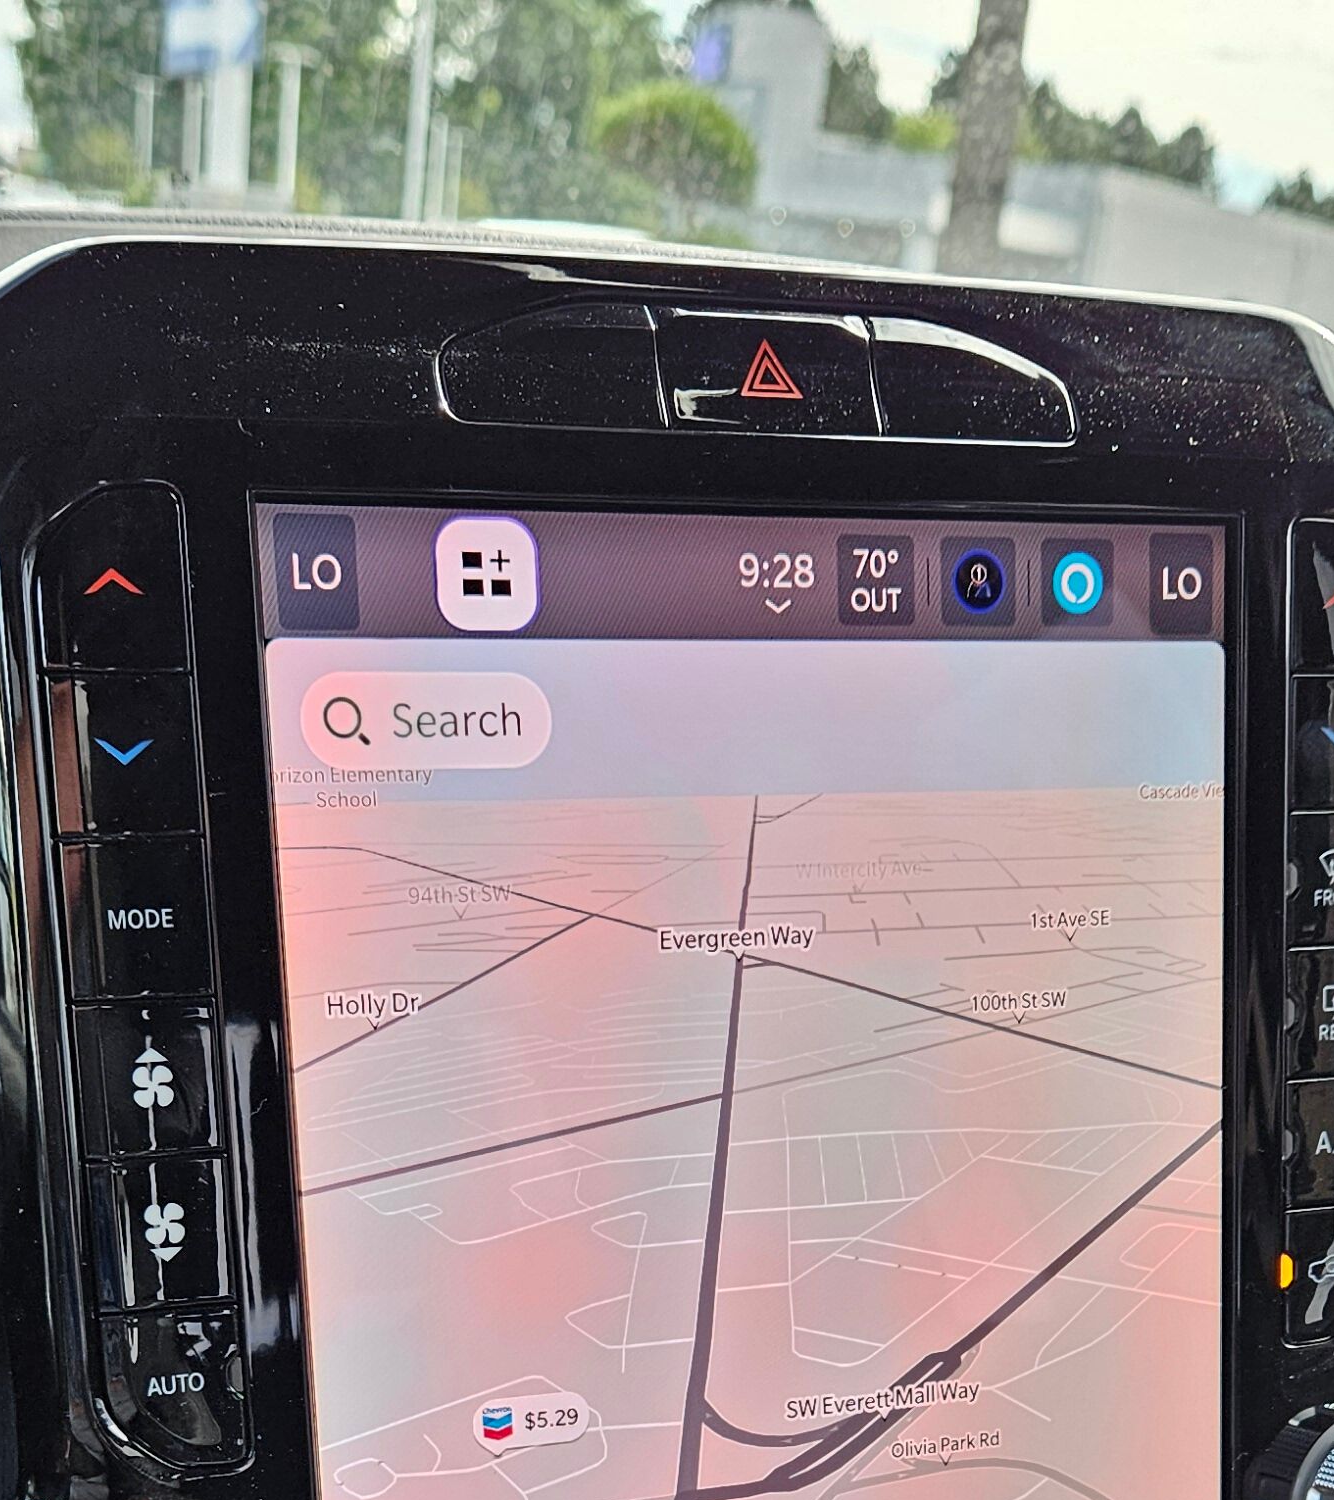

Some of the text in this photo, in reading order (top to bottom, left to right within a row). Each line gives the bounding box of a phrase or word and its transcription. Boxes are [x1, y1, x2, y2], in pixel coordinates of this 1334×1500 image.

[291, 552, 342, 590] LO
[738, 552, 815, 589] 9:28
[852, 547, 899, 580] 70°
[1161, 566, 1203, 601] LO
[850, 587, 902, 613] OUT
[392, 702, 522, 739] Search
[330, 767, 432, 785] Elementary
[317, 791, 377, 808] School
[1139, 782, 1225, 799] Cascade Vie
[890, 860, 922, 877] Ave
[407, 884, 511, 905] 94th St SW
[106, 908, 175, 931] MODE
[1030, 910, 1111, 929] 1st Ave SE
[659, 926, 814, 953] Evergreen Way
[326, 992, 420, 1018] Holly Dr
[970, 991, 1067, 1012] 100th St SW
[146, 1371, 206, 1398] AUTO
[786, 1381, 981, 1419] SW Everett Mall Way
[524, 1408, 579, 1432] $5.29
[890, 1430, 1000, 1459] Olivia Park Rd
